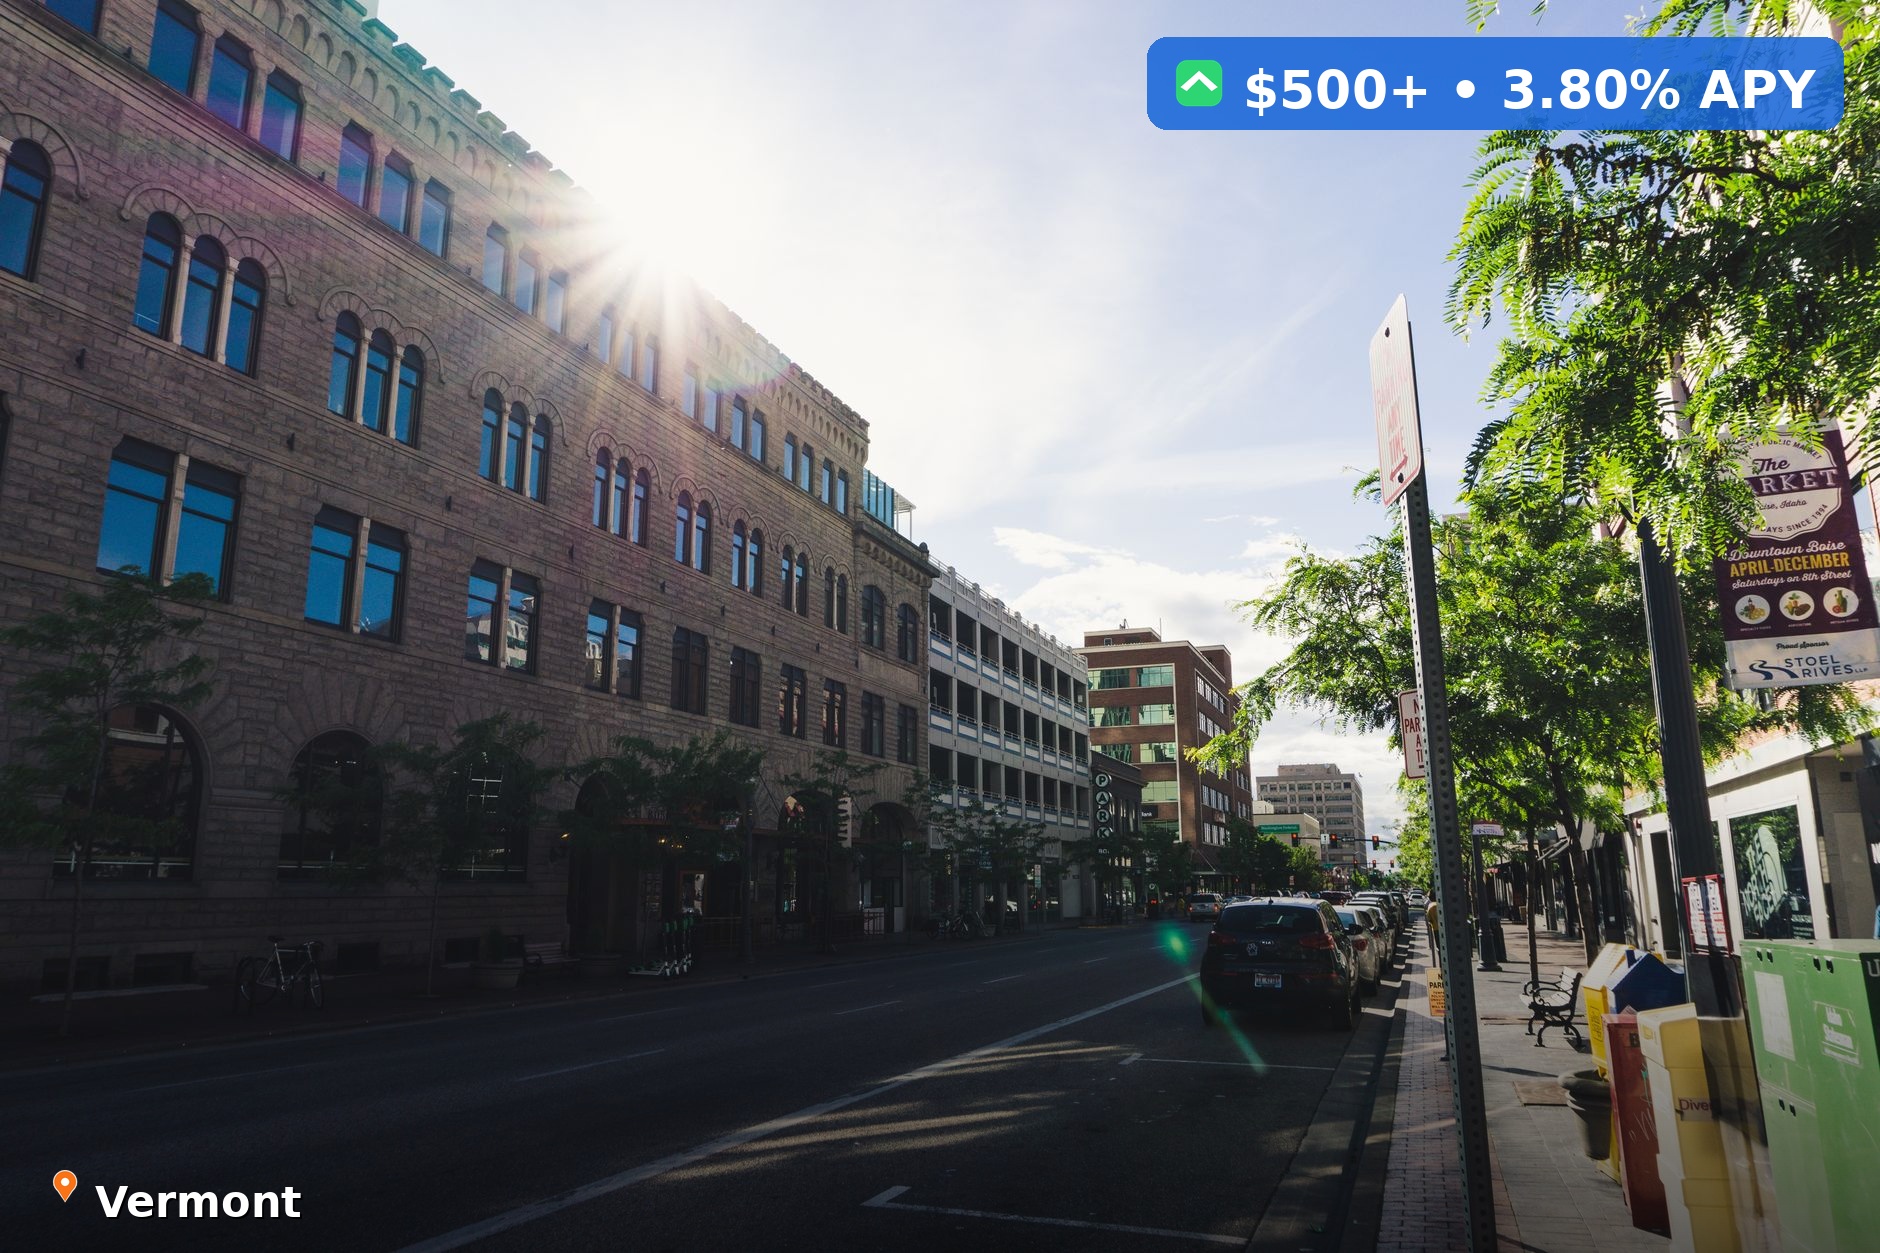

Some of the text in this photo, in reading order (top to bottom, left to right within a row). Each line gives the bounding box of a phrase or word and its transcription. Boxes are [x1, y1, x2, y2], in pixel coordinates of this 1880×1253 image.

[1752, 457, 1790, 472] The
[1746, 469, 1838, 495] RKET
[1780, 499, 1807, 510] Idaho
[1786, 518, 1812, 532] SINCE
[1811, 503, 1828, 520] 1994
[1728, 540, 1846, 562] Downtown Boise
[1730, 551, 1851, 578] APRIL-DECEMBER
[1732, 569, 1853, 591] Saturdays on 8th Street
[1776, 642, 1799, 650] Proud
[1784, 654, 1841, 668] STOEL
[1801, 664, 1854, 678] RIVES
[1404, 717, 1421, 733] PAR
[1096, 773, 1109, 839] PARK
[1429, 981, 1444, 989] PAR
